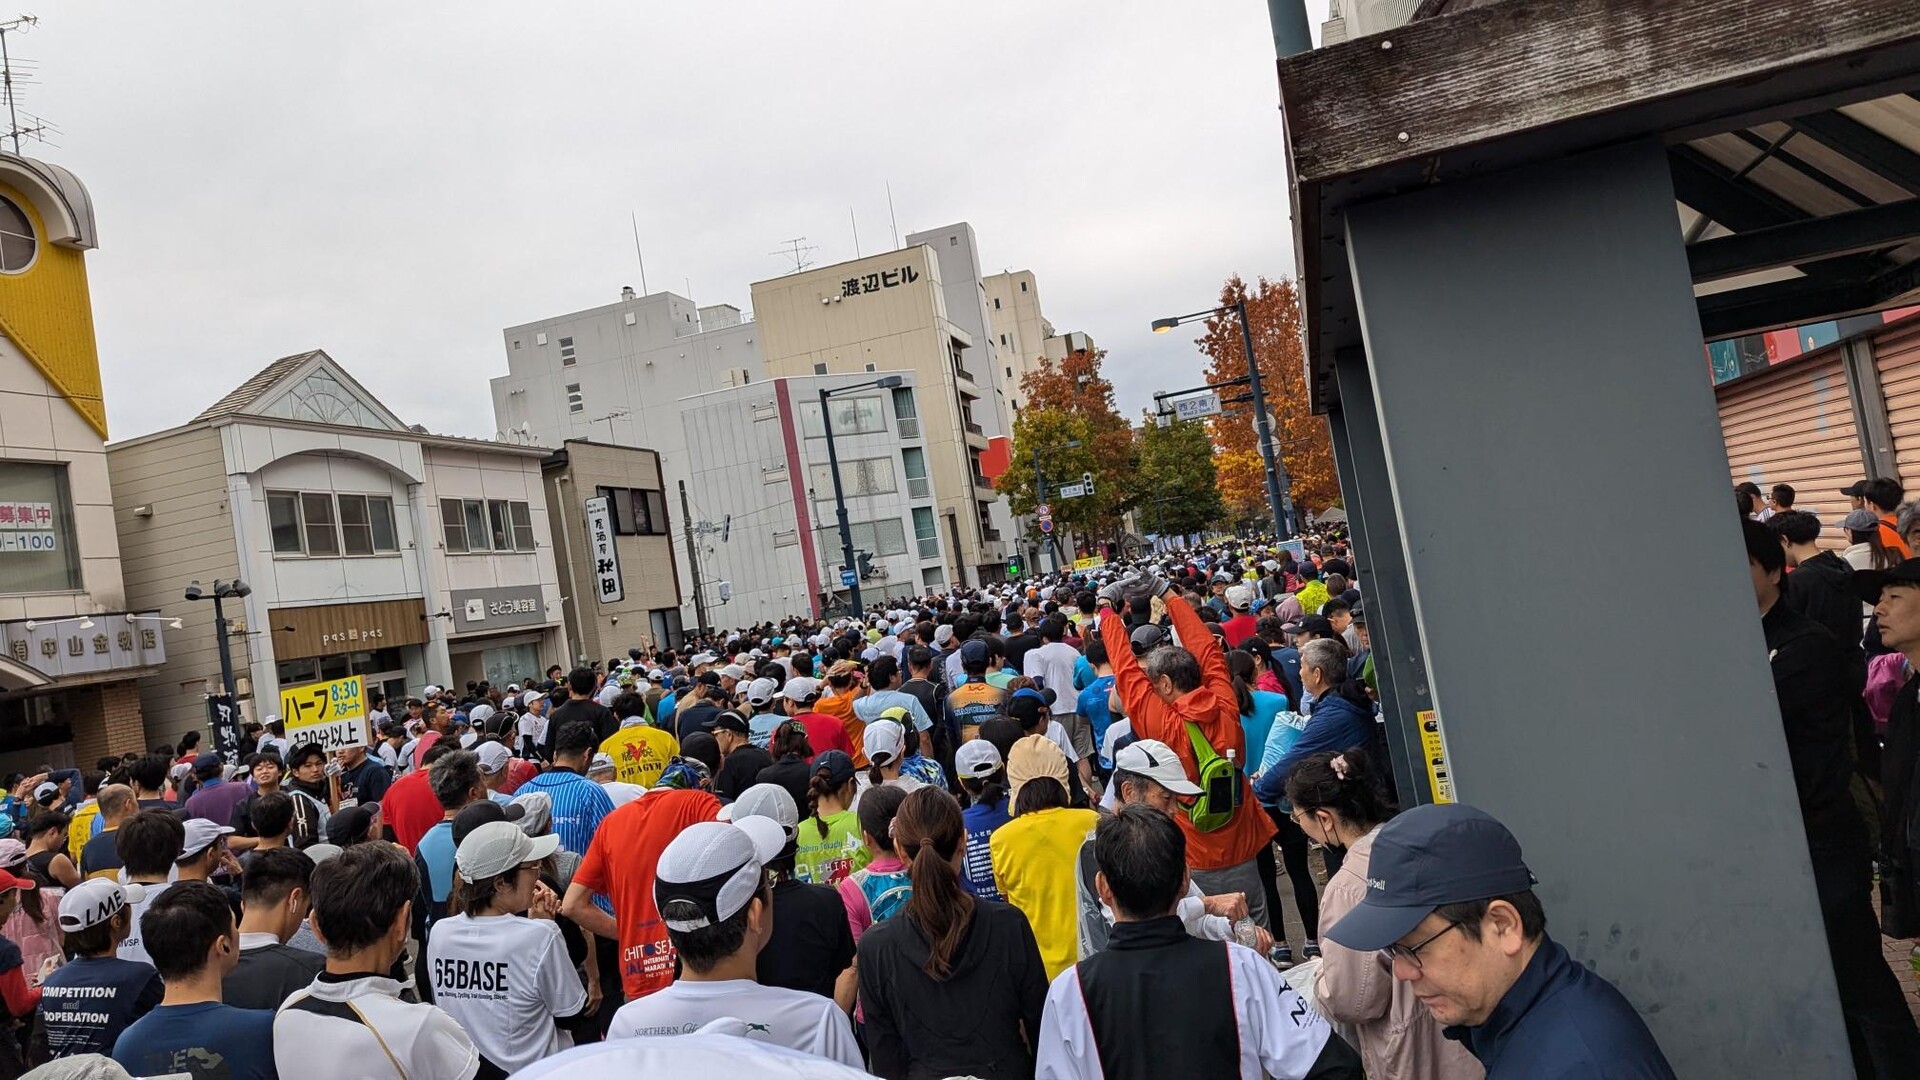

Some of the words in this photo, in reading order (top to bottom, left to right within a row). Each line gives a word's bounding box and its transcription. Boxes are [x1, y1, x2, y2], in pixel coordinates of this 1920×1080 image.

[841, 265, 919, 297] 渡辺ビル
[0, 535, 54, 549] -100
[489, 598, 537, 616] さとう美容室
[322, 632, 346, 647] pas
[362, 628, 383, 642] pas
[331, 680, 358, 702] 8:30
[285, 688, 329, 724] ハーフ
[333, 699, 360, 717] スタート
[85, 890, 124, 926] LME
[435, 958, 509, 991] 65BASE
[42, 987, 117, 998] COMPETITION
[634, 1026, 679, 1037] NORTHERN
